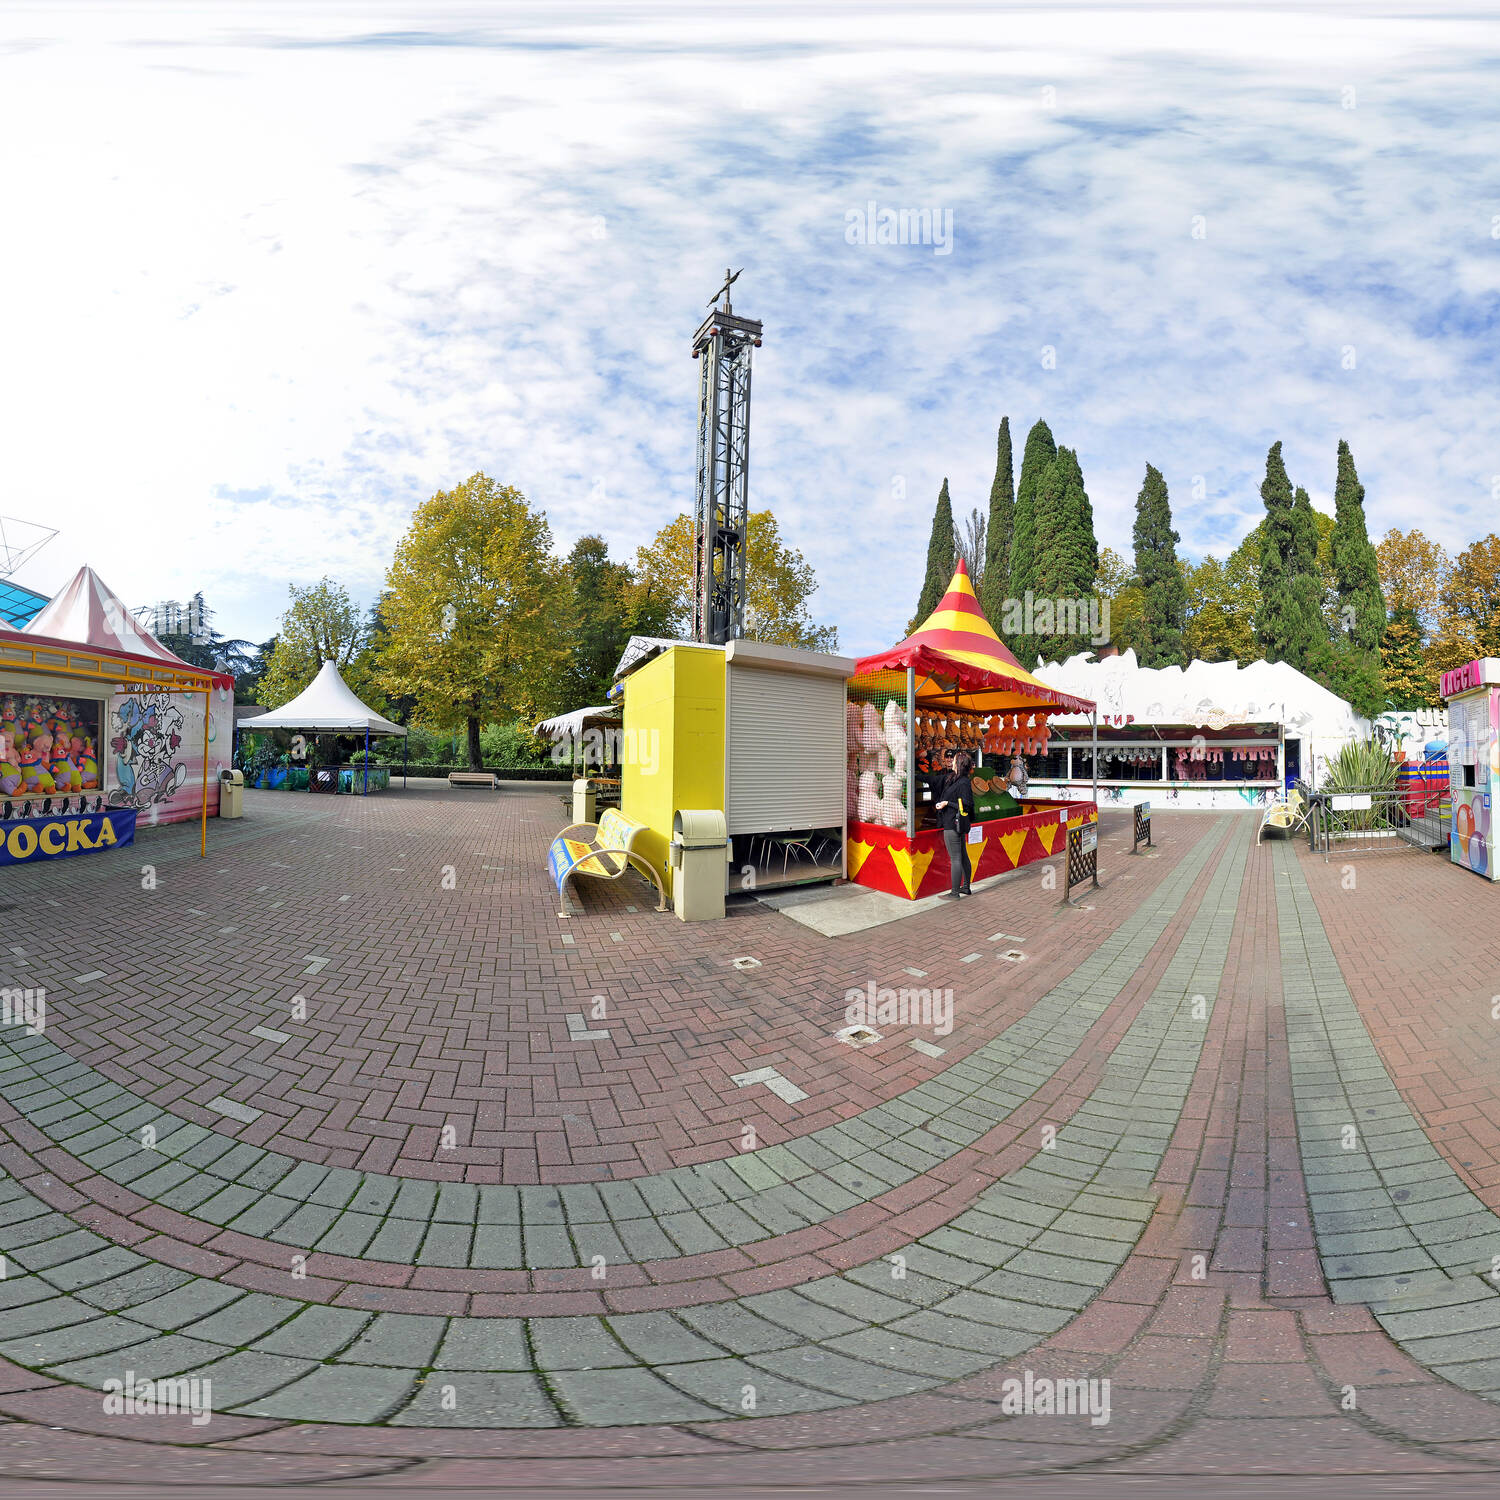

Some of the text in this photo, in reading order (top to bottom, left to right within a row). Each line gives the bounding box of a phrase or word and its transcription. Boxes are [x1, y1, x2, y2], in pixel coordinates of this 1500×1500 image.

[1440, 660, 1481, 697] КАССА
[1103, 714, 1135, 726] ТИР
[0, 817, 117, 858] ОСКА
